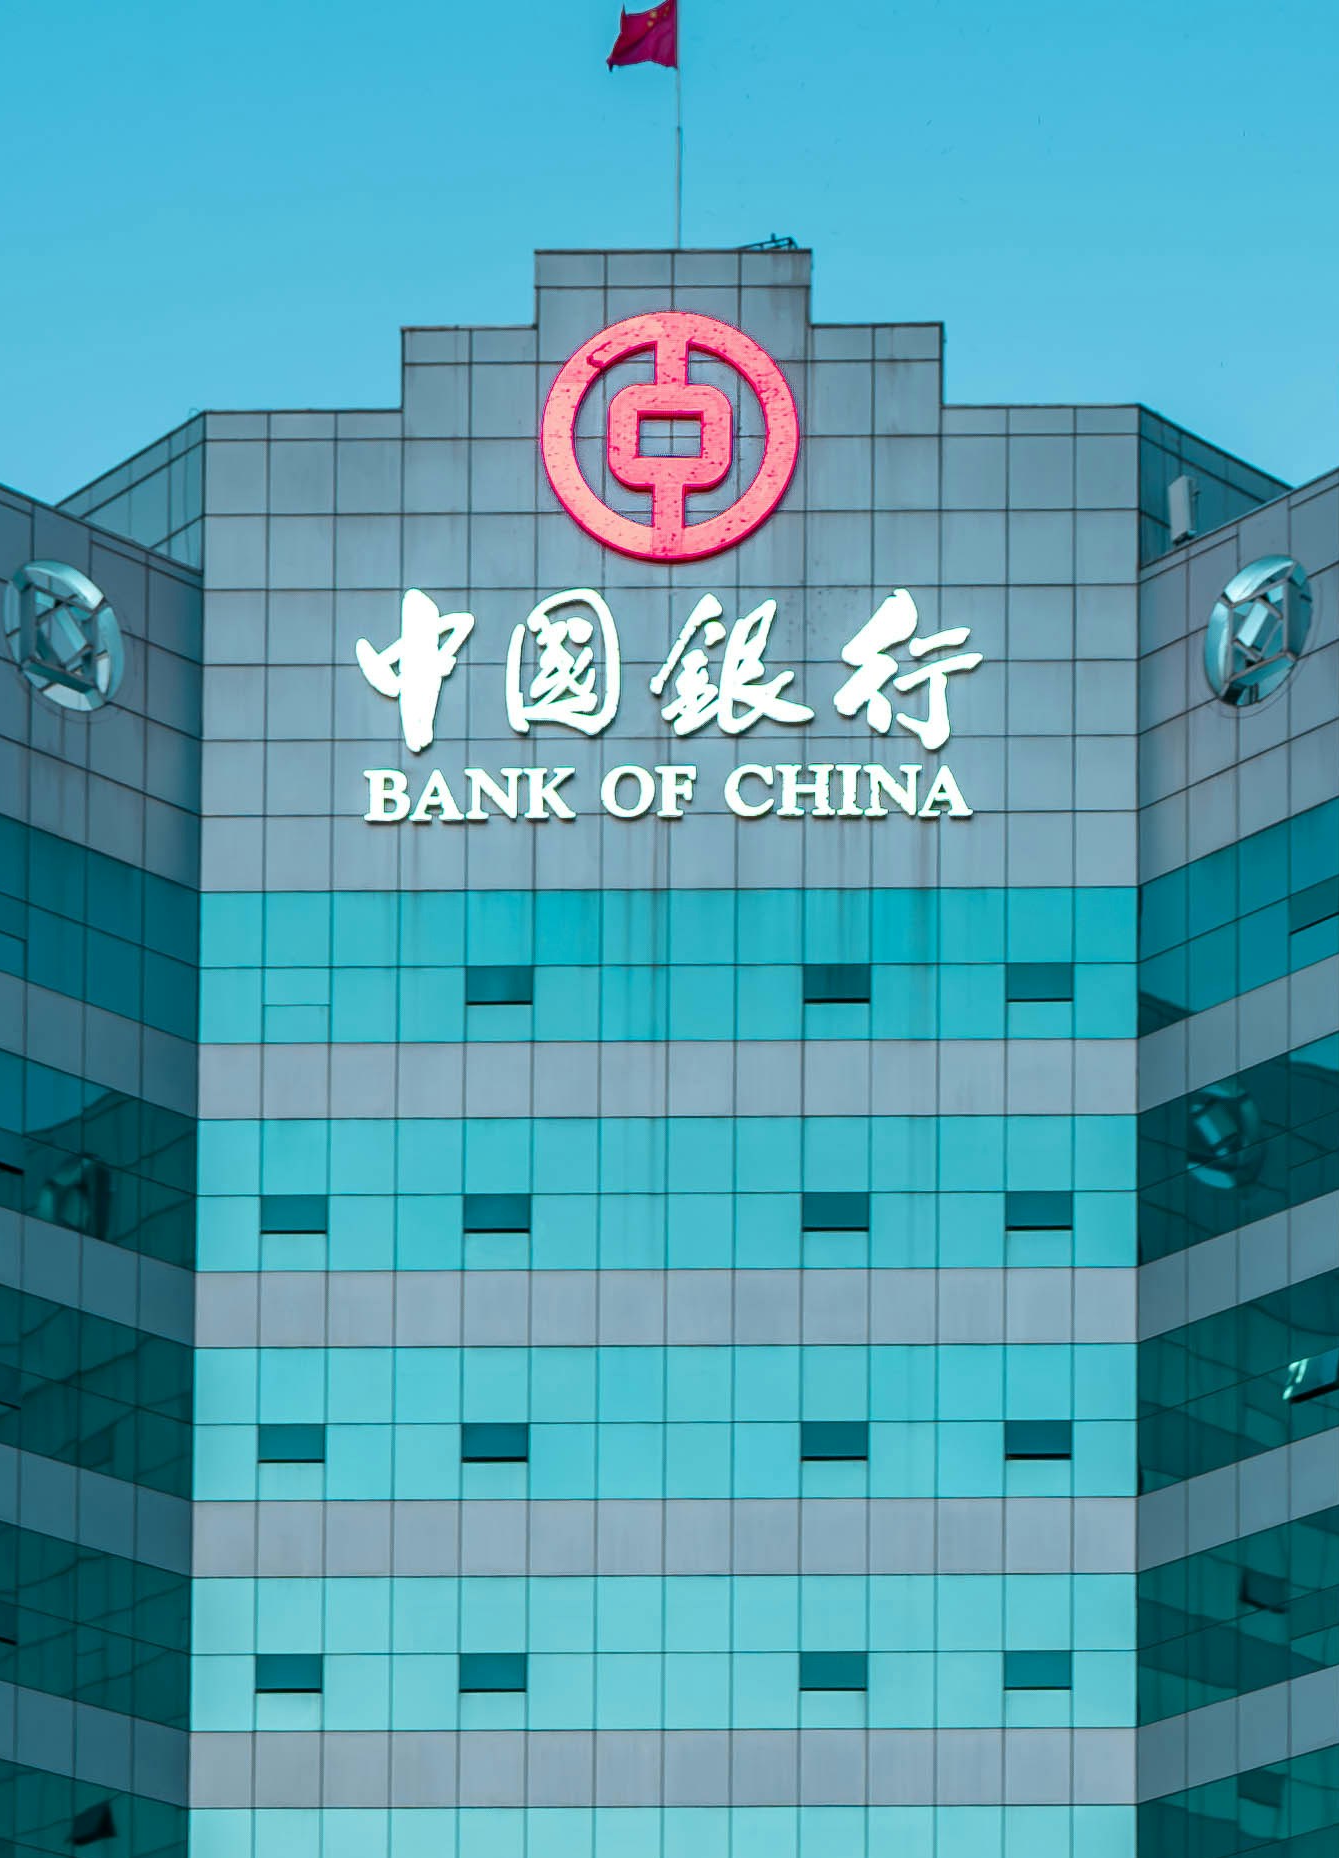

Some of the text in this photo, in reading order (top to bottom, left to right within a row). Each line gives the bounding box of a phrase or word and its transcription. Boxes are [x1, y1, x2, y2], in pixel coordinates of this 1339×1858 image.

[355, 587, 984, 753] 中國銀行
[362, 762, 974, 823] BANK OF CHINA
